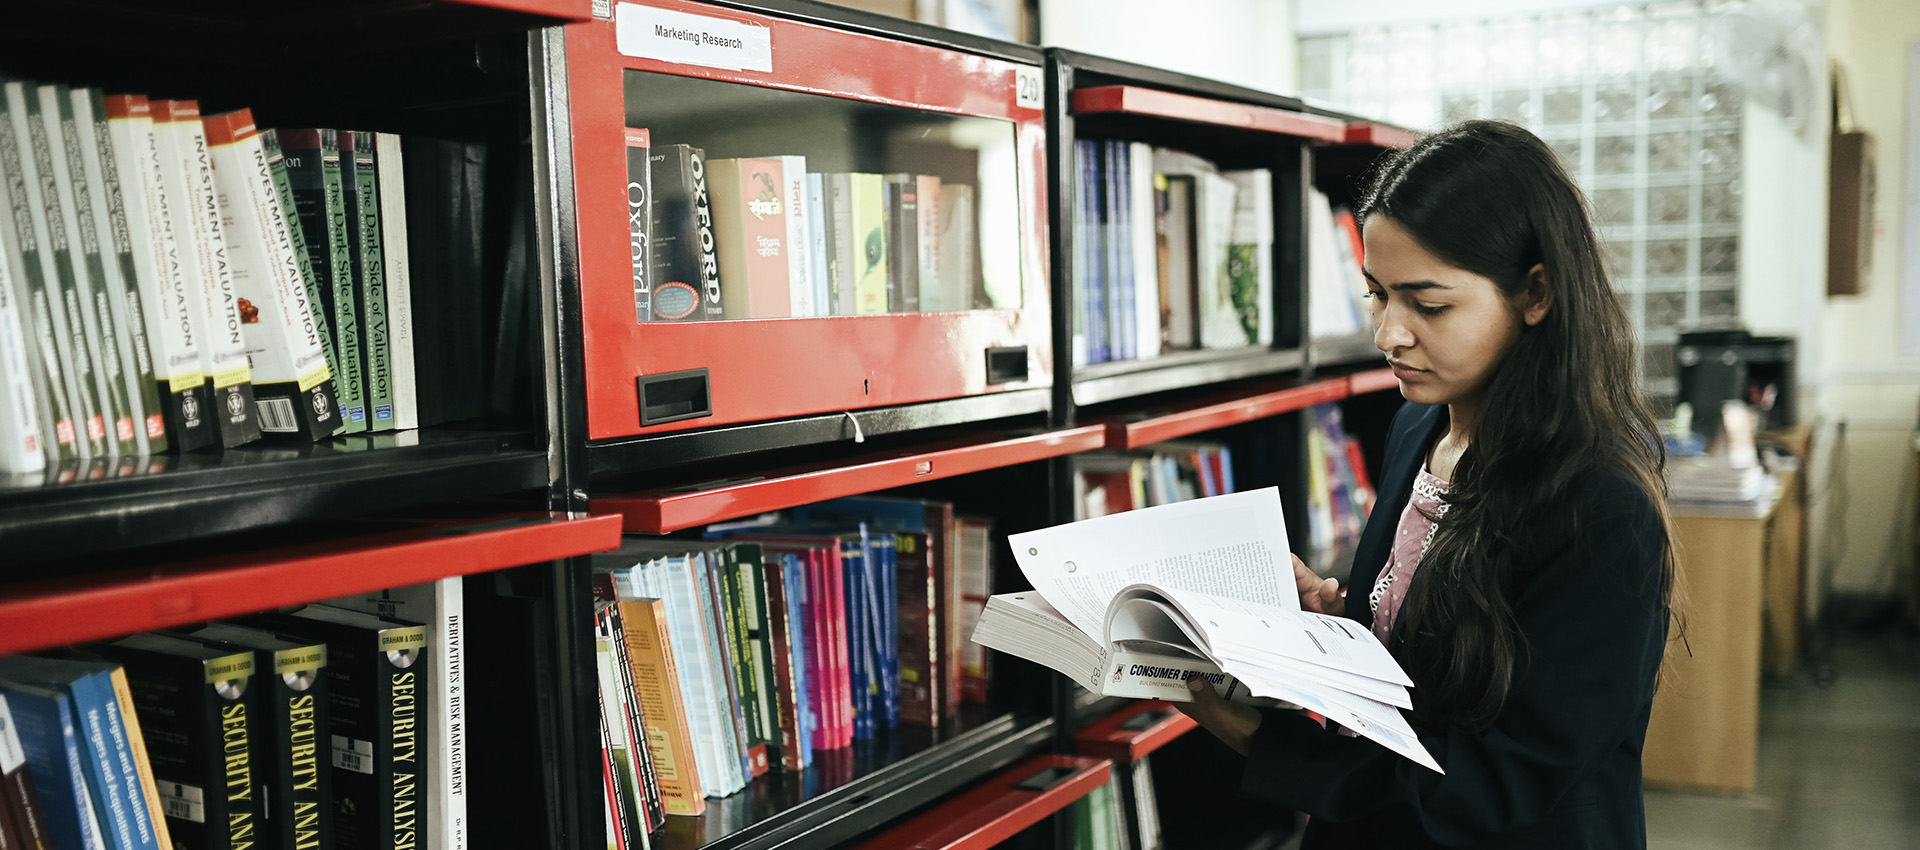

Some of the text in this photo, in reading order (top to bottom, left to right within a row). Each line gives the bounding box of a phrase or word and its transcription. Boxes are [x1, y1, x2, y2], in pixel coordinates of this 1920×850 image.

[655, 24, 742, 49] Marketing Research
[1019, 75, 1039, 101] 20
[111, 190, 130, 252] VALUATION
[147, 131, 173, 241] INVESTMENT
[168, 248, 193, 346] VALUATION
[194, 134, 221, 242] INVESTMENT
[215, 248, 240, 344] VALUATION
[253, 148, 317, 346] INVESTMENT VALUATION
[628, 181, 649, 294] Oxford
[690, 153, 721, 304] OXFORD
[277, 181, 342, 399] The Dark Side of Valuation
[329, 179, 361, 401] The Dark Side of Valuation
[362, 181, 389, 399] The Dark Side of Valuation
[209, 664, 231, 676] GRAHAM
[277, 657, 300, 666] GRAHAM
[382, 636, 403, 645] GRAHAM
[449, 616, 459, 683] DERIVATIVES
[1130, 664, 1180, 680] CONSUMER
[1139, 680, 1161, 688] BUILDING
[289, 695, 317, 790] SECURITY
[392, 672, 415, 762] SECURITY
[450, 696, 460, 720] RISK
[67, 746, 86, 804] MERGERS
[86, 709, 133, 850] Mergers and Acquisitions
[105, 701, 151, 844] Mergers and Acquisitions
[222, 704, 255, 850] SECURITY ANA
[451, 724, 462, 795] MANAGEMENT
